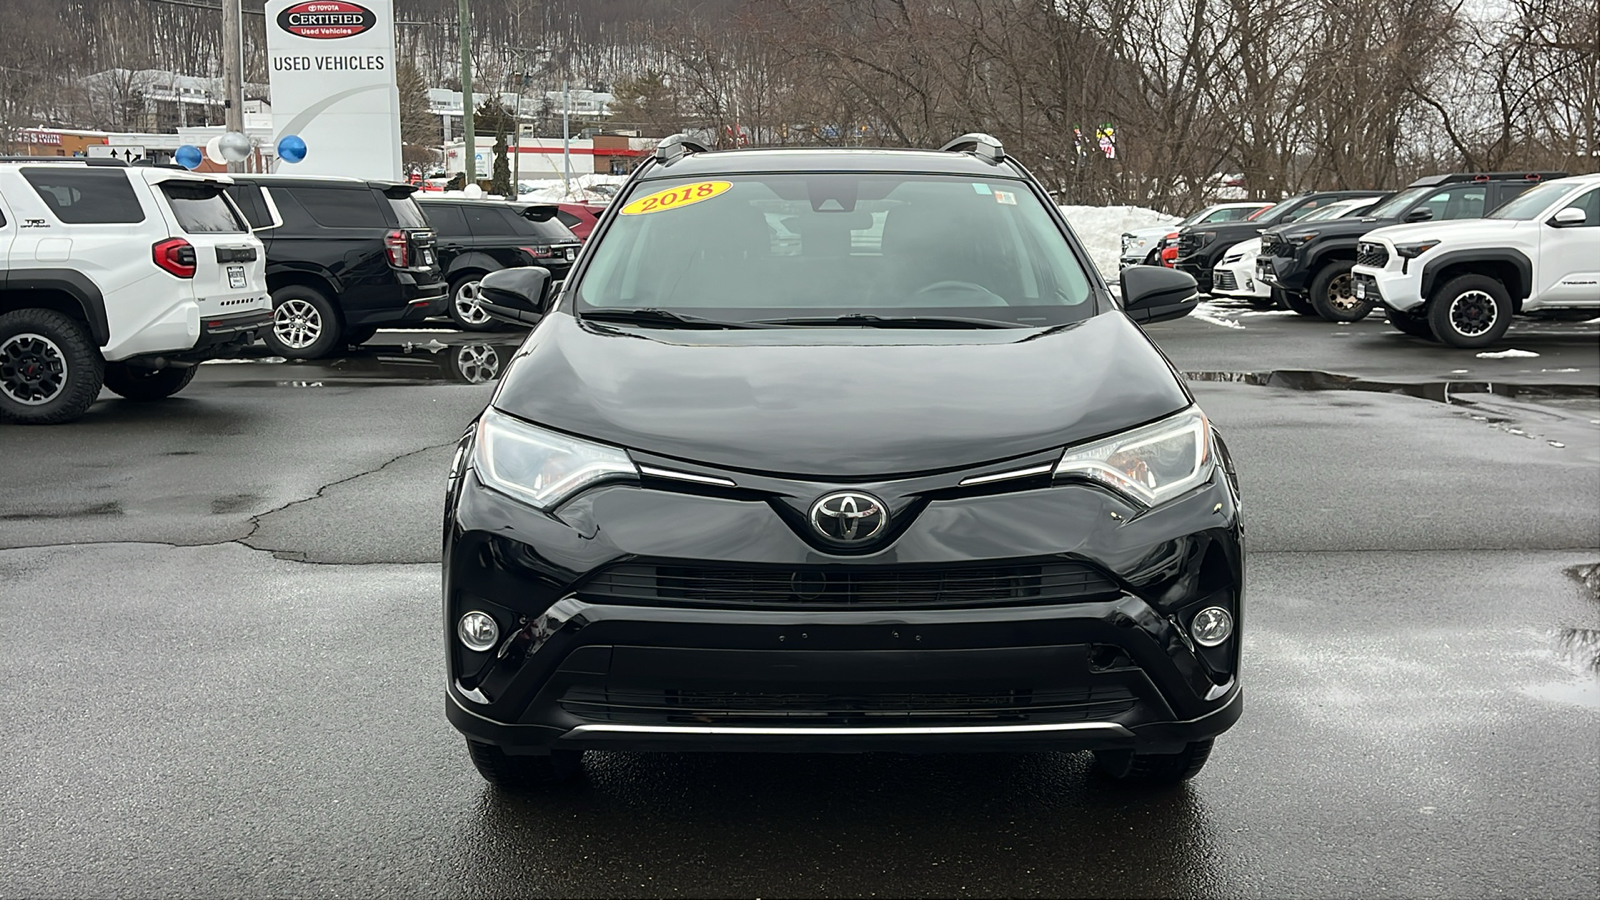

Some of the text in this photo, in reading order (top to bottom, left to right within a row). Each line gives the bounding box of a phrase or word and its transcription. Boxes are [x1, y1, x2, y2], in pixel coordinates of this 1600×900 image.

[288, 13, 364, 25] CERTIFIED
[273, 55, 385, 71] USED VEHICLES
[641, 183, 713, 212] 2018
